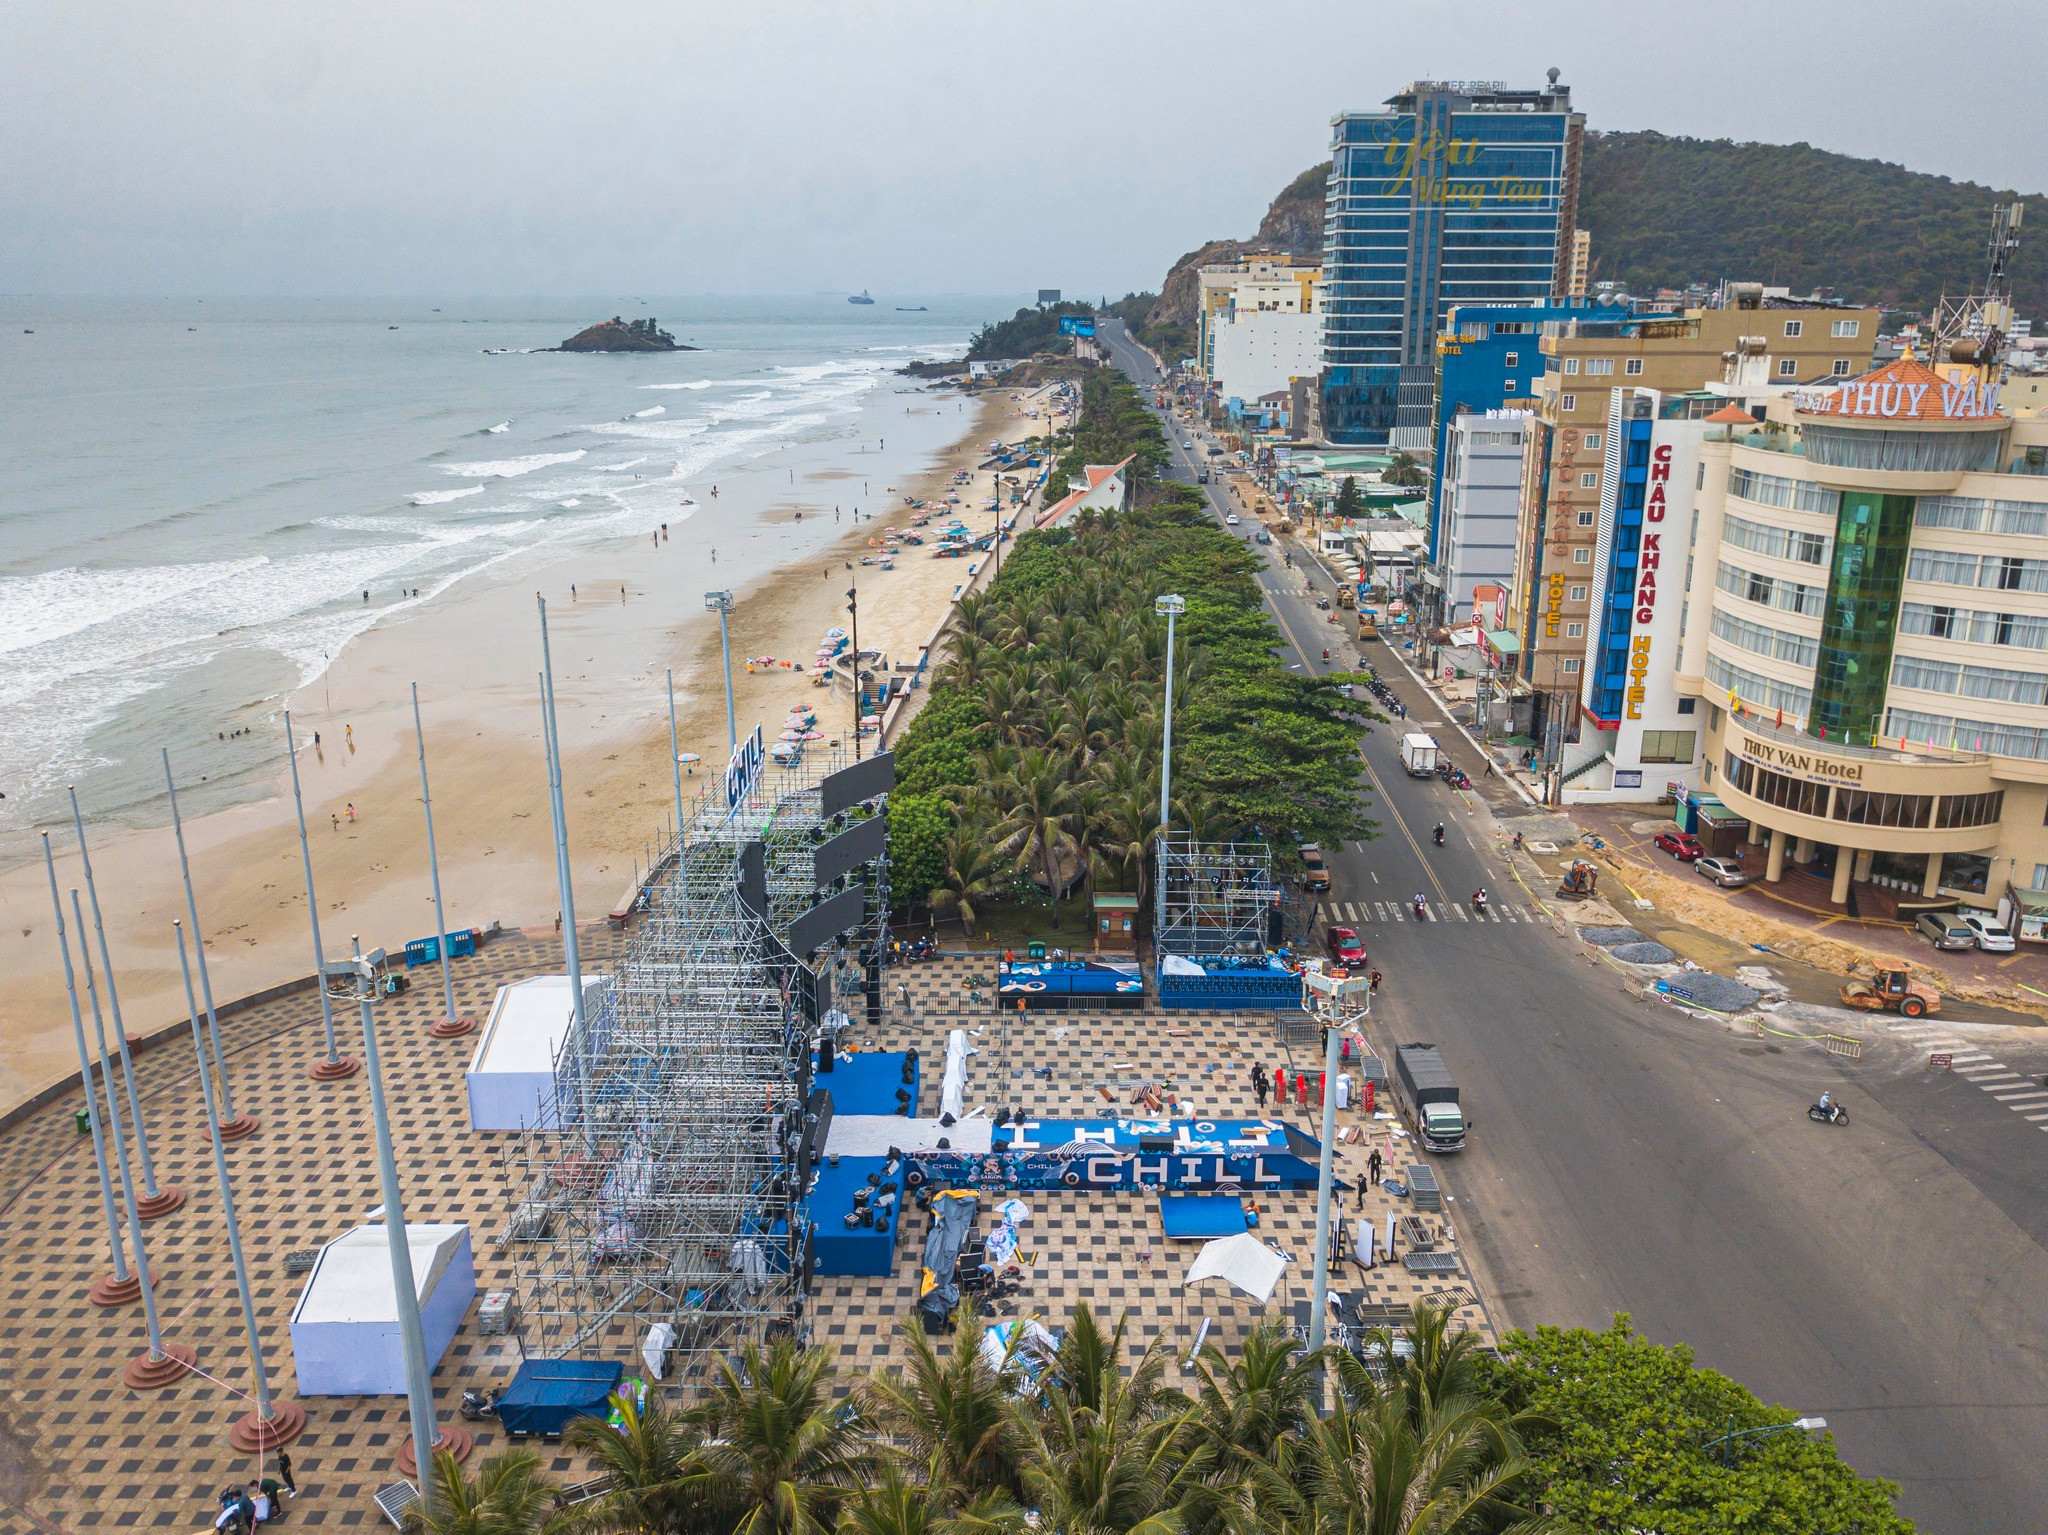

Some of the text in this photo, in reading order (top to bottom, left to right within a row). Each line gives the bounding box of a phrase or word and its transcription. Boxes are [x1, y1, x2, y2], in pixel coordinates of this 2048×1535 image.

[1437, 346, 1462, 355] HOTEL
[1438, 334, 1476, 344] BLUE SEA
[1940, 374, 2001, 417] VÂN
[1636, 534, 1661, 624] KHANG
[1546, 573, 1565, 637] HOTEL
[1626, 636, 1651, 719] HOTEL
[1743, 737, 1775, 761] THUY
[1778, 750, 1810, 771] VAN
[1814, 758, 1863, 781] Hotel
[1087, 1157, 1281, 1182] CHILL
